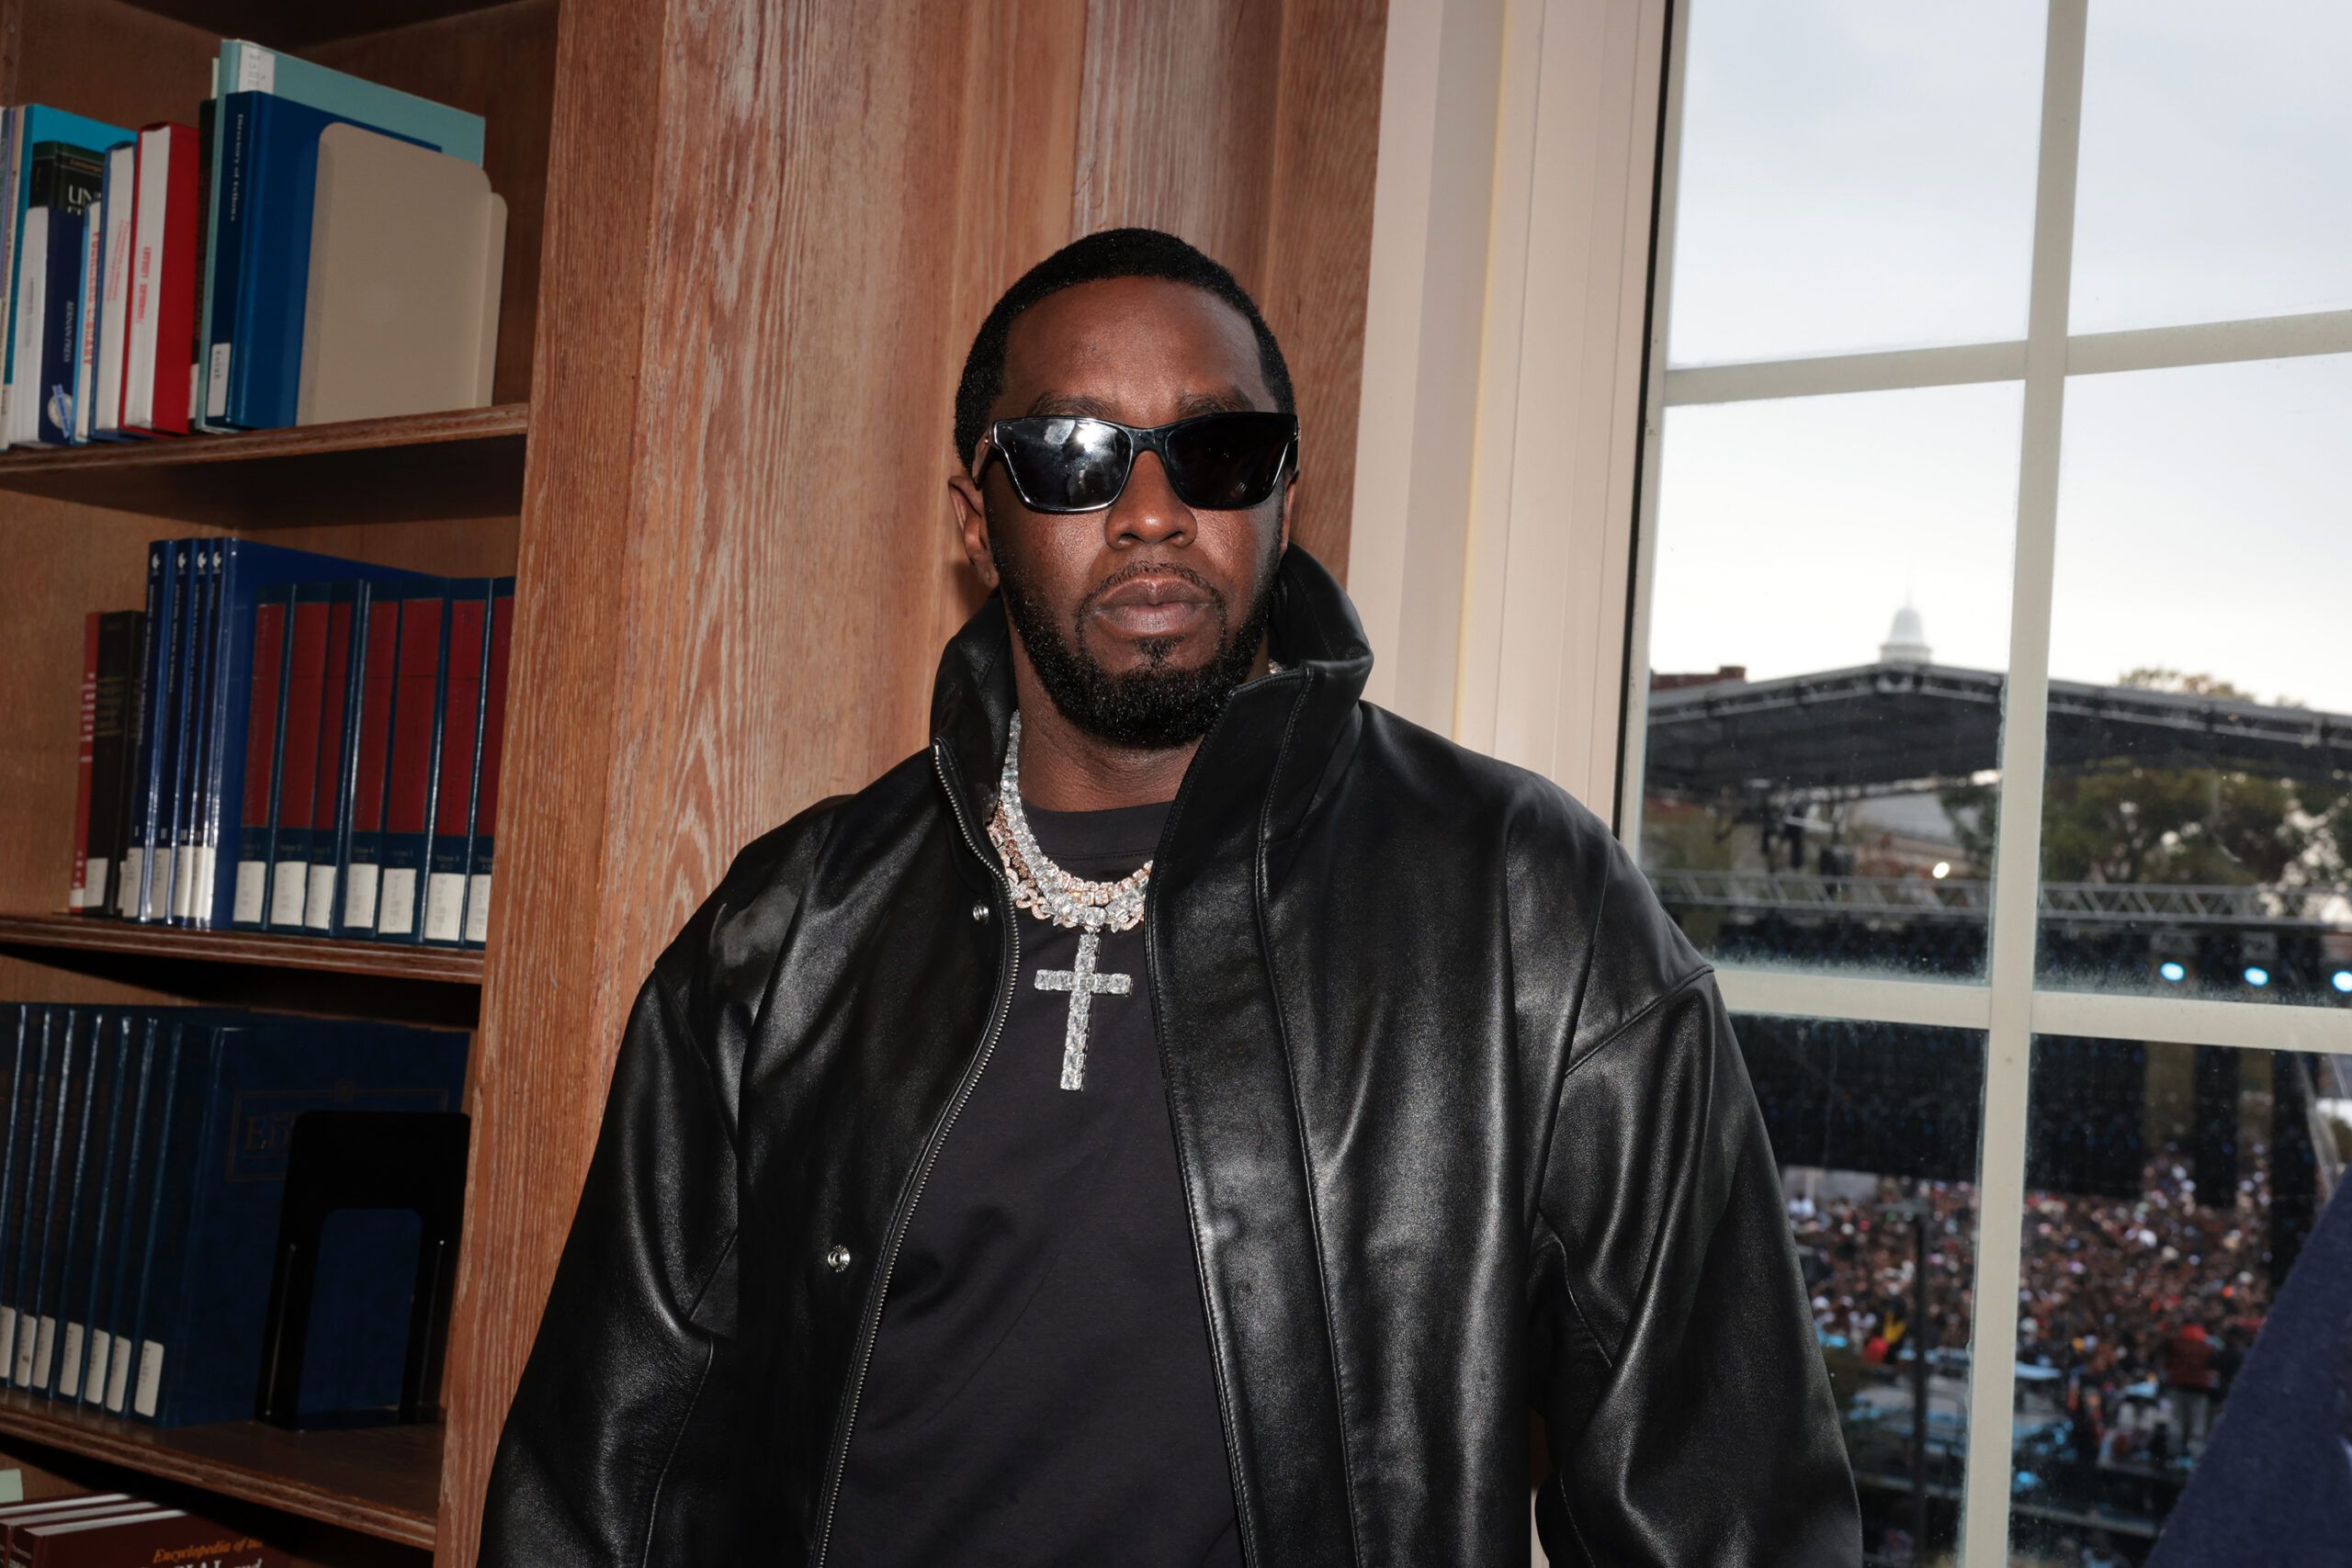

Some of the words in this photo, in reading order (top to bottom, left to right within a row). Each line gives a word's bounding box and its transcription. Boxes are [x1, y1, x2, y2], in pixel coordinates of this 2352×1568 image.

[234, 114, 244, 164] Directory
[231, 181, 239, 221] Fellows
[65, 299, 74, 337] BERNAN
[63, 338, 73, 364] PRESS
[153, 1540, 231, 1563] Encyclopedia
[233, 1536, 249, 1554] of
